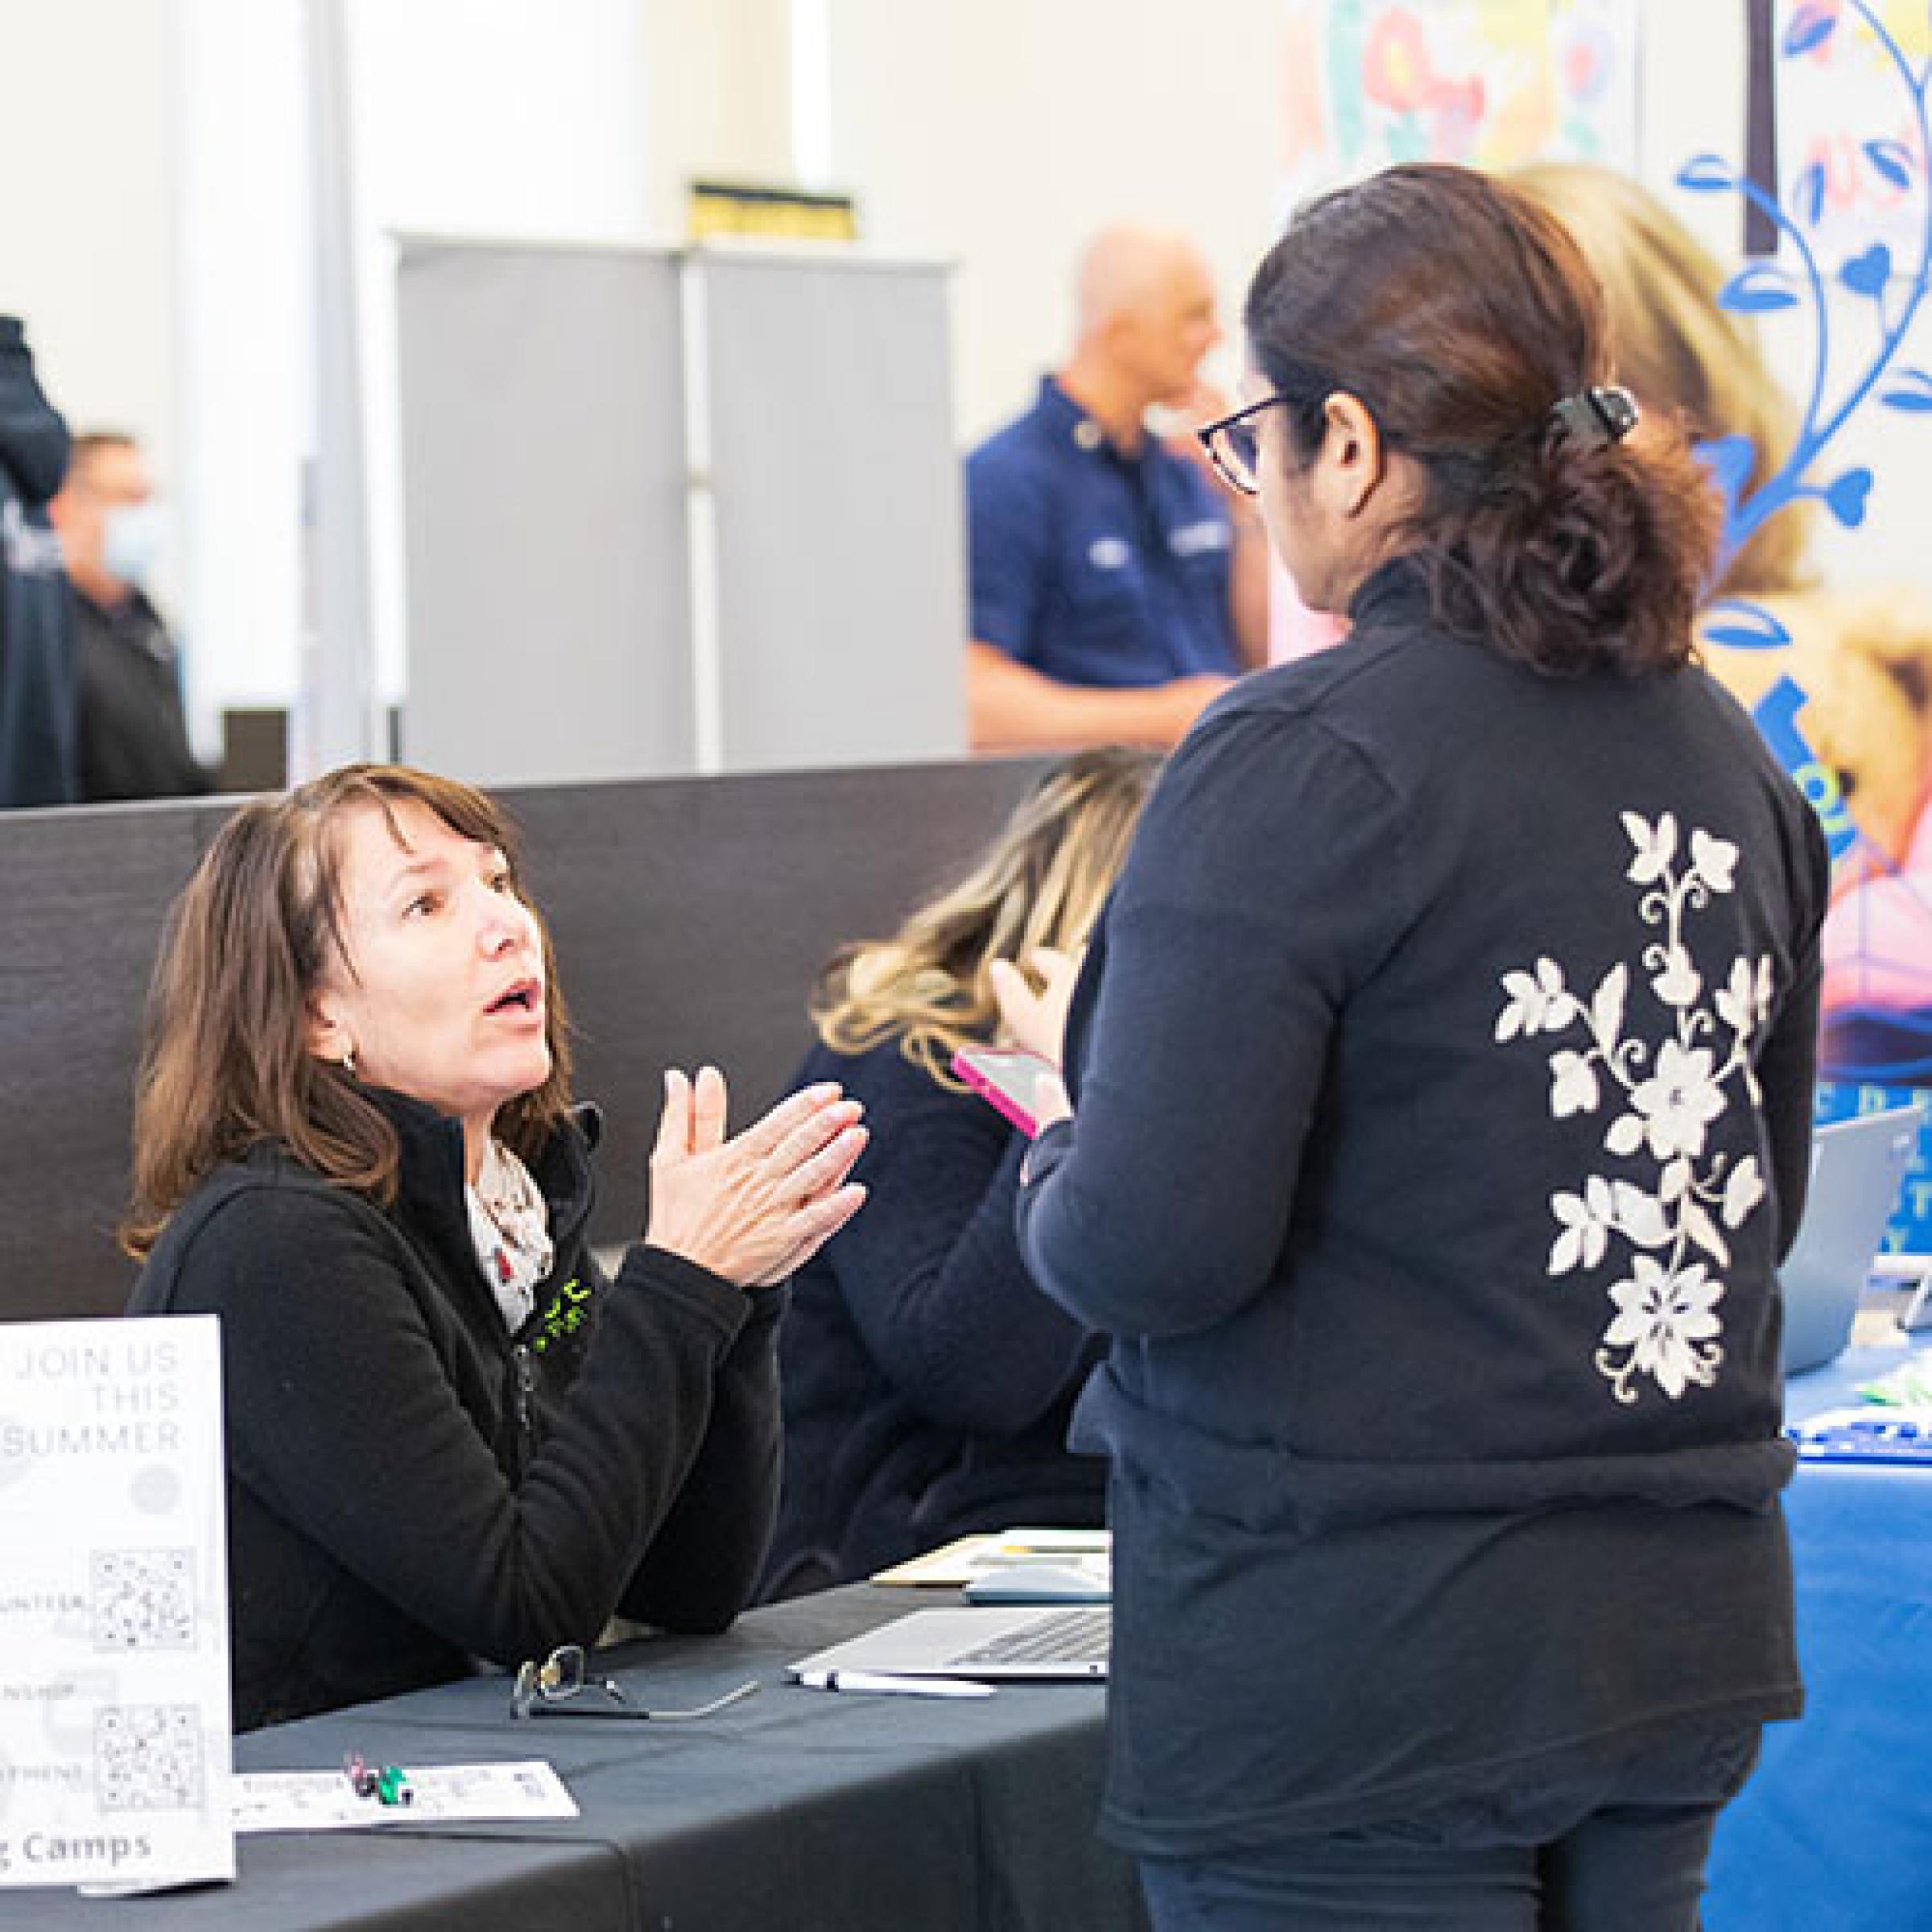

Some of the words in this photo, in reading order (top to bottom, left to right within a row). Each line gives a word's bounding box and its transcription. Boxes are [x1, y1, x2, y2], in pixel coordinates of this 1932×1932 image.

[15, 1346, 109, 1380] JOIN
[127, 1341, 180, 1375] US
[91, 1380, 180, 1413] THIS
[3, 1419, 181, 1457] SUMMER
[23, 1831, 151, 1868] Camps
